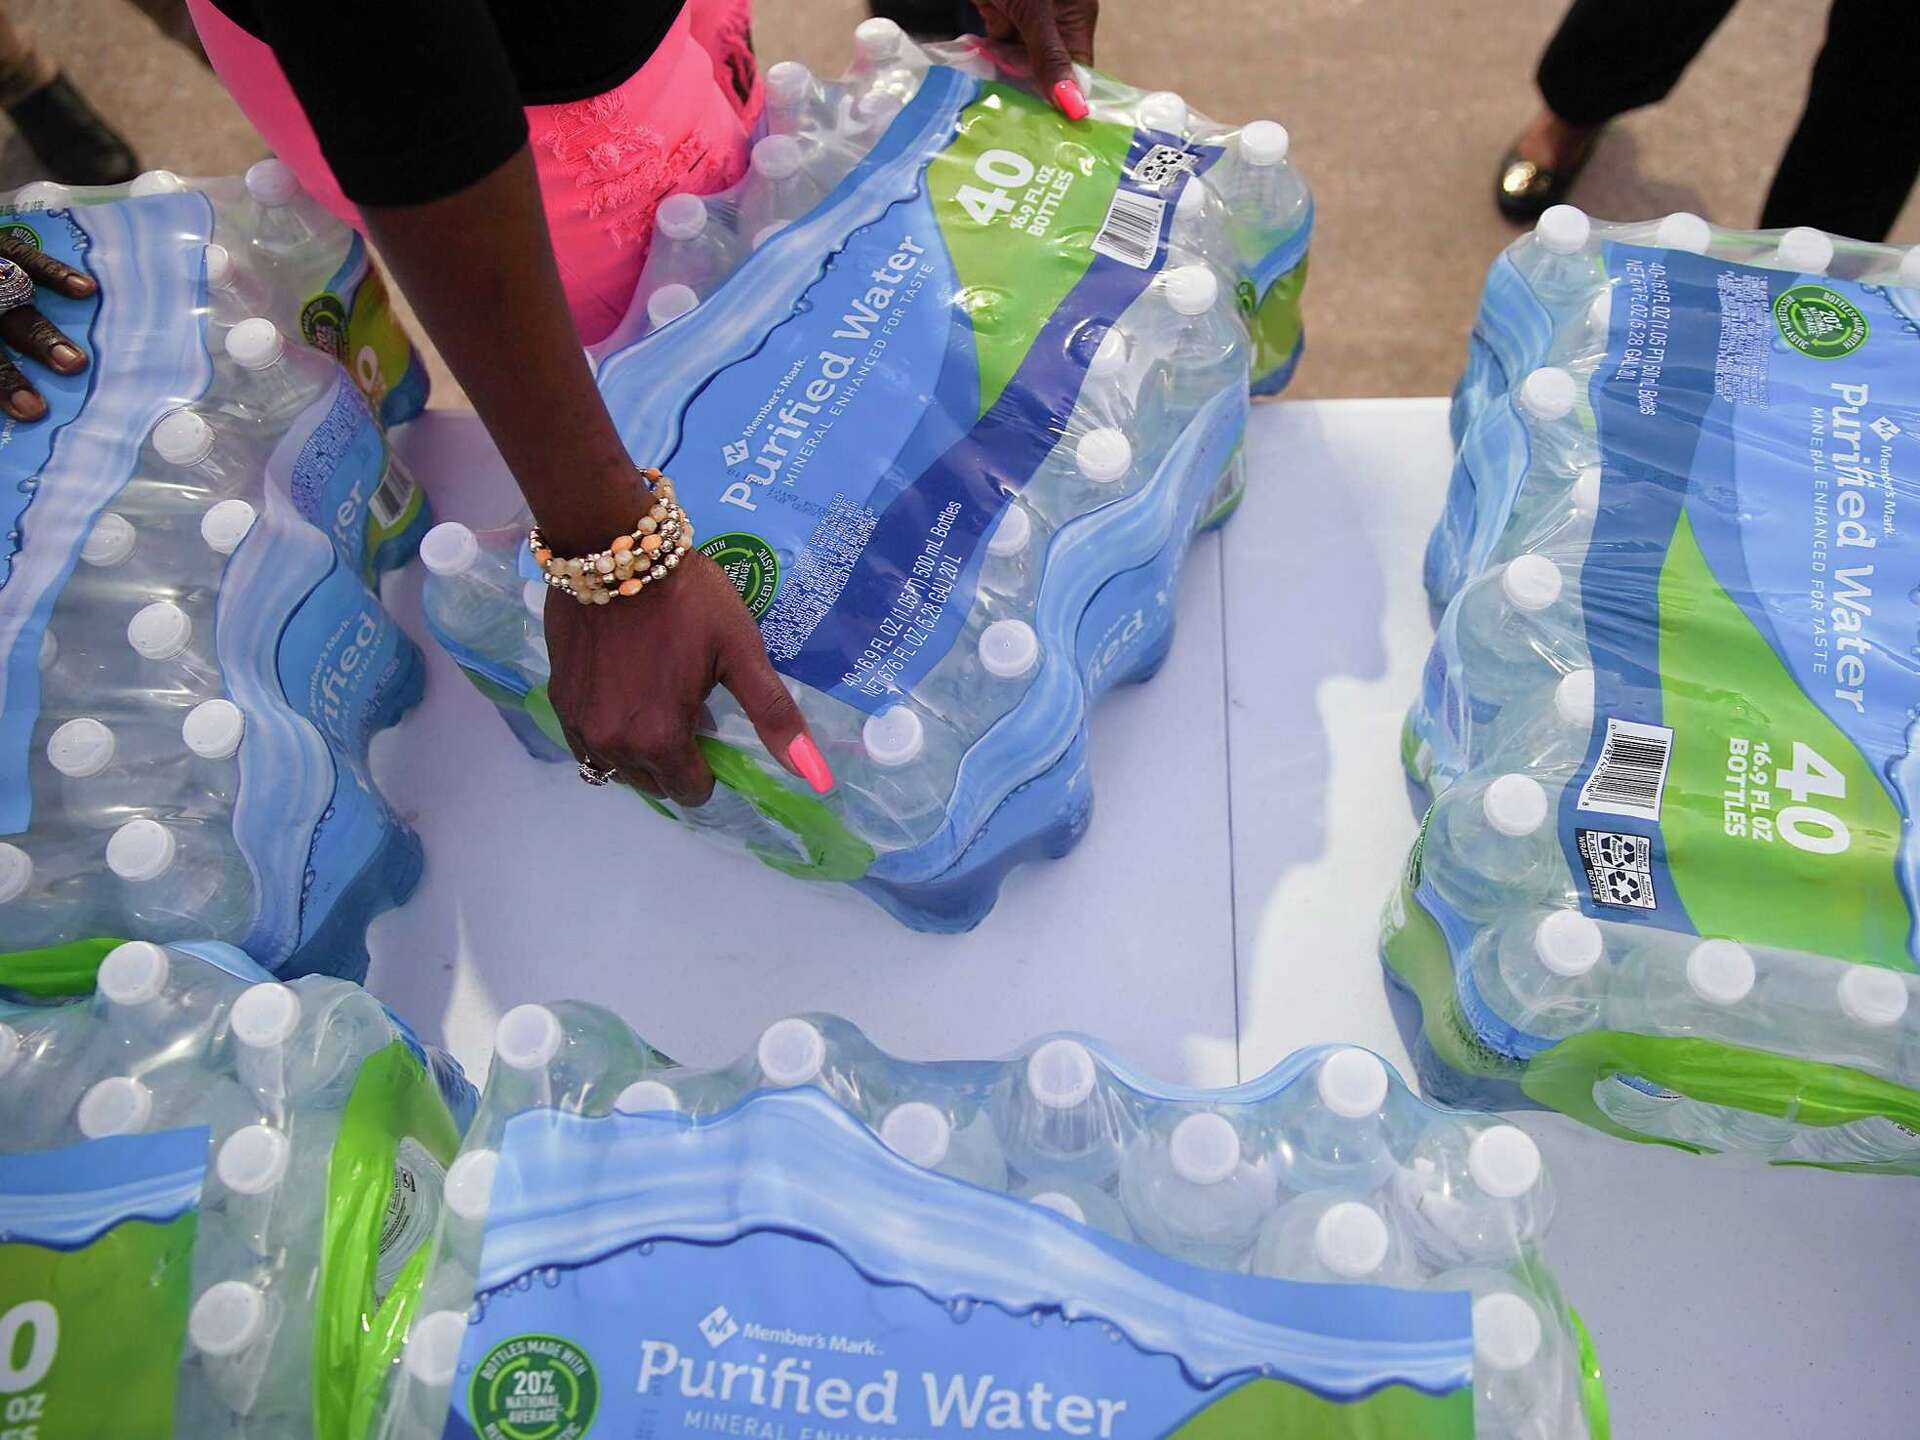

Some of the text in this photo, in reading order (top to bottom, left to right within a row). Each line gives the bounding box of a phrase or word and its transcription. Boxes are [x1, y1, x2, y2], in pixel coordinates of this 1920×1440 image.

[955, 150, 1034, 226] 40
[1009, 162, 1056, 230] 16.9 FL OZ
[1025, 167, 1074, 237] BOTTLES
[1626, 259, 1644, 277] NET
[1629, 304, 1647, 317] OZ
[1652, 295, 1667, 303] FL
[1652, 306, 1669, 318] OZ
[1626, 318, 1646, 346] (5.28
[1646, 319, 1668, 345] (1.05
[1778, 296, 1808, 349] RECYCLED PLASTIC
[1807, 307, 1826, 334] NATIONAL
[1819, 310, 1843, 330] 20%
[1822, 292, 1864, 349] BOTTLES MADE WITH
[345, 343, 385, 391] 0
[1643, 347, 1664, 363] PT)
[718, 343, 856, 512] Purified
[831, 233, 926, 344] Water
[779, 260, 935, 488] MINERAL ENHANCED FOR TASTE
[741, 357, 806, 438] Member's Mark
[1638, 389, 1657, 415] Bottles
[932, 501, 961, 538] Bottles
[1882, 500, 1895, 534] Mark
[702, 539, 726, 555] WITH
[766, 607, 777, 620] ON
[777, 570, 797, 602] JOURNEY
[809, 524, 824, 546] USING
[821, 491, 844, 525] RECYCLED
[927, 536, 944, 557] mL
[1808, 407, 1827, 673] MINERAL ENHANCED FOR TASTE
[1830, 383, 1876, 712] Purified Water
[756, 547, 775, 581] PLASTIC
[775, 621, 796, 647] YEARLY
[791, 590, 817, 623] NATIONAL
[813, 561, 834, 592] AVERAGE
[829, 552, 840, 564] OF
[841, 508, 864, 542] RECYCLED
[795, 608, 814, 633] BASED
[809, 599, 821, 611] ON
[821, 563, 844, 596] NATIONAL
[837, 544, 855, 565] MASS
[848, 515, 869, 546] BALANCE
[913, 553, 935, 579] 500
[763, 619, 788, 651] ECYCLED
[802, 576, 815, 591] OUR
[811, 548, 831, 578] BOTTLES
[825, 536, 838, 550] ARE
[833, 516, 849, 537] MADE
[776, 585, 800, 620] ALTHOUGH
[796, 569, 809, 586] THIS
[786, 603, 831, 660] POST-CONSUMER
[825, 570, 850, 606] RECYCLED
[844, 543, 863, 572] PLASTIC
[891, 589, 919, 621] (1.05
[861, 550, 962, 698] NET 676 FL OZ (5.28 GAL) 20 L
[879, 615, 903, 638] OZ
[870, 632, 893, 654] FL
[842, 648, 882, 687] 40-16.9
[1723, 738, 1749, 837] BOTTLES
[1748, 742, 1772, 841] 16.9 FL OZ
[1775, 741, 1850, 854] 40
[1578, 836, 1588, 858] WRAP
[1587, 833, 1598, 864] PLASTIC
[1587, 869, 1599, 899] BOTTLE
[1596, 869, 1607, 899] PLASTIC
[743, 1323, 877, 1355] Member's Mark
[481, 1341, 588, 1380] BOTTLES MADE WITH
[513, 1370, 556, 1395] 20%
[636, 1340, 898, 1424] Purified
[922, 1372, 1126, 1437] Water
[505, 1394, 559, 1408] NATIONAL
[684, 1410, 785, 1440] MINERAL
